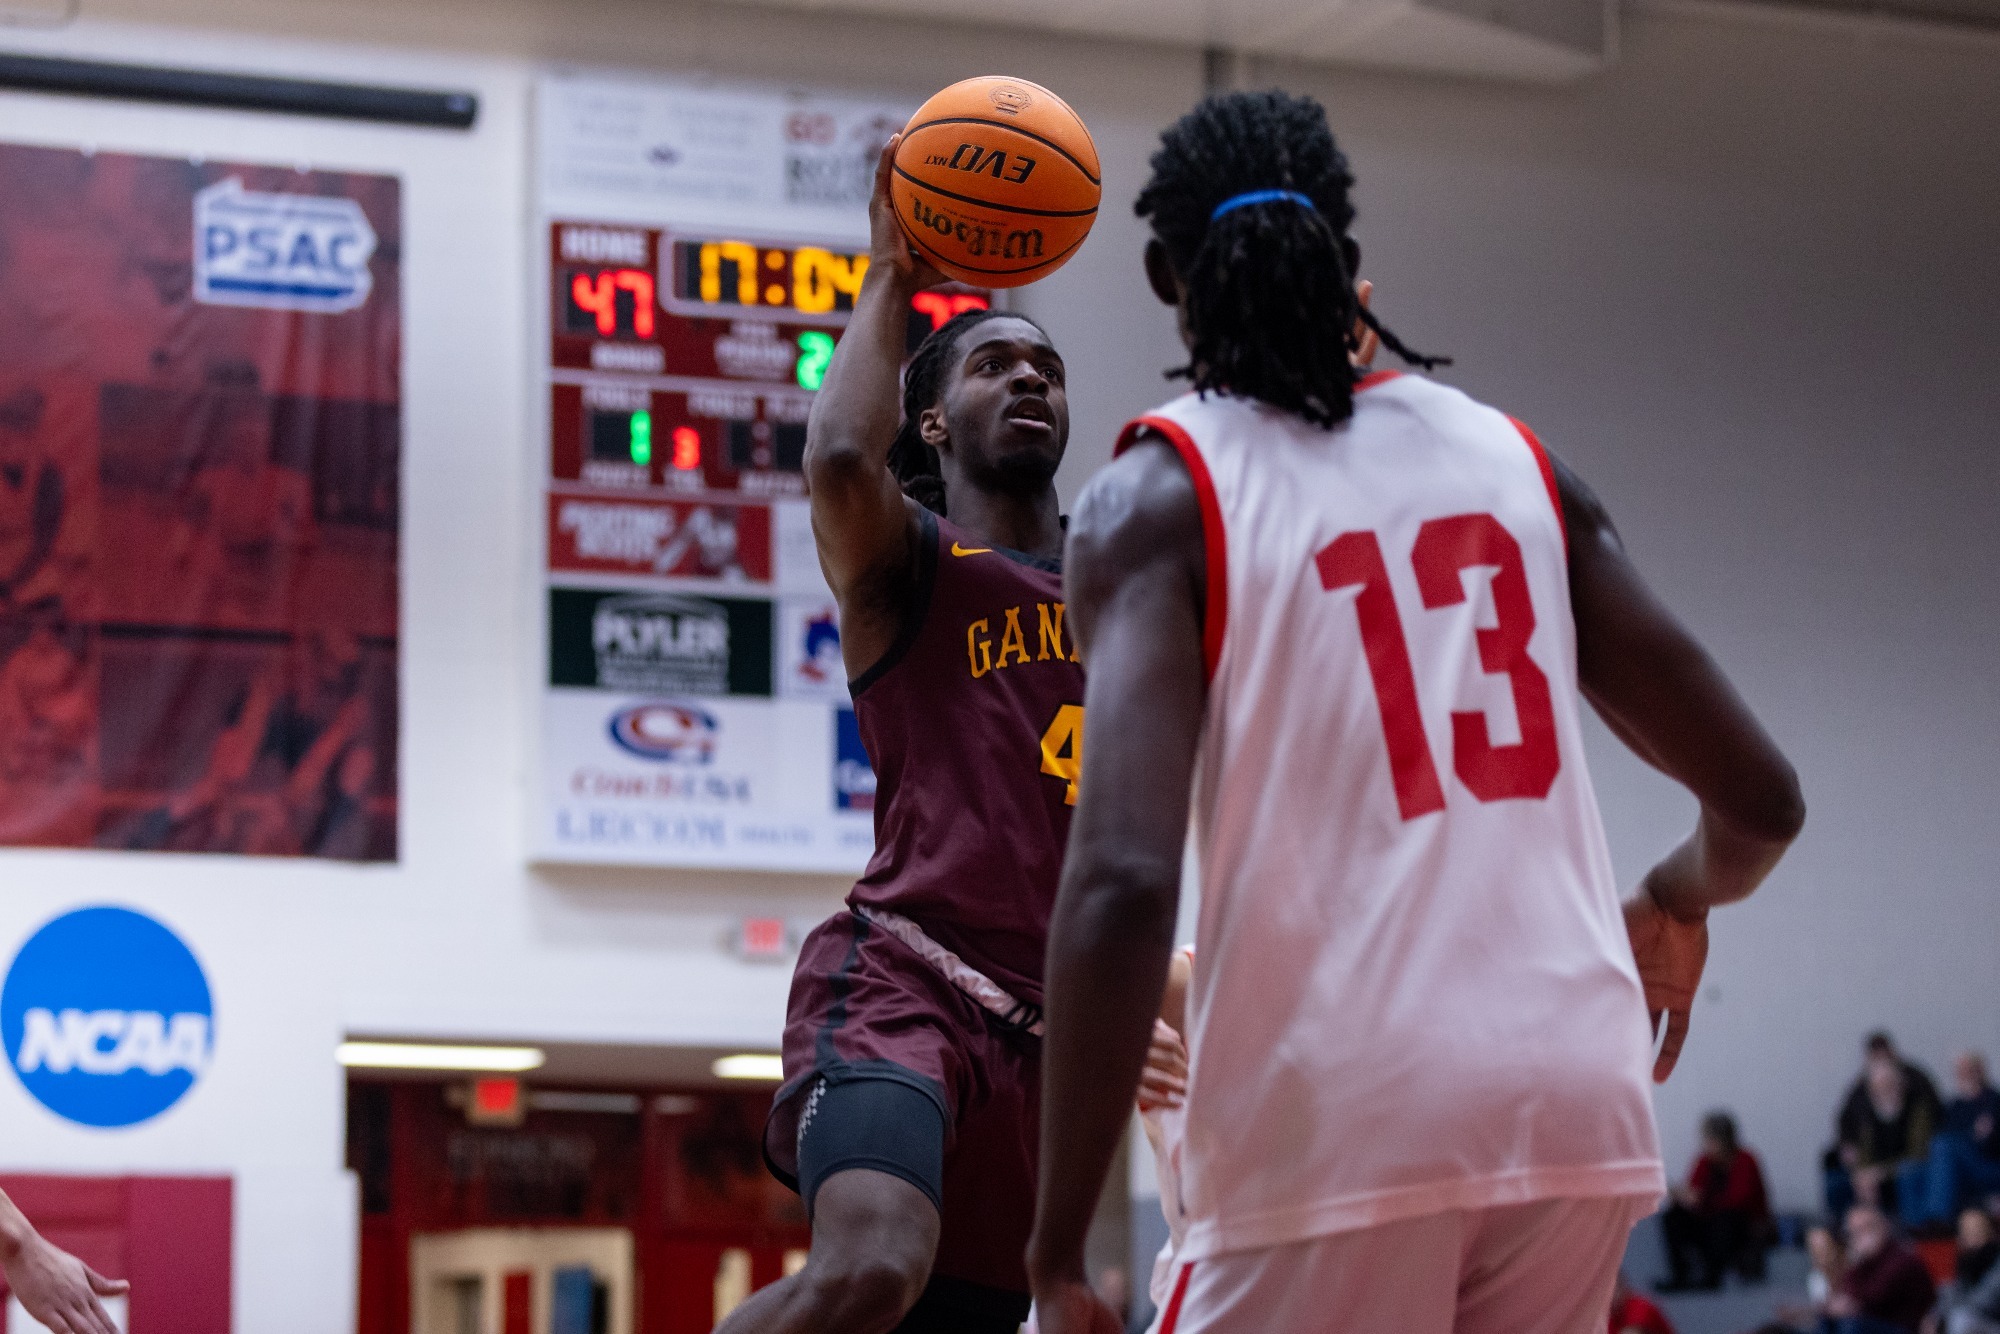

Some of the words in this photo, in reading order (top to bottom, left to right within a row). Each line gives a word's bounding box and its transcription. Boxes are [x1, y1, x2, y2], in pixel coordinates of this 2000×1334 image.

[924, 154, 948, 166] NXT
[948, 143, 1036, 184] EVO
[206, 224, 357, 275] PSAC
[560, 228, 648, 263] HOME
[912, 195, 1044, 259] Wilson
[572, 270, 654, 338] 47
[700, 241, 870, 313] 17:04
[797, 331, 835, 391] 2
[967, 602, 1081, 679] GAN
[1315, 512, 1561, 821] 13
[17, 1006, 209, 1077] NCAA
